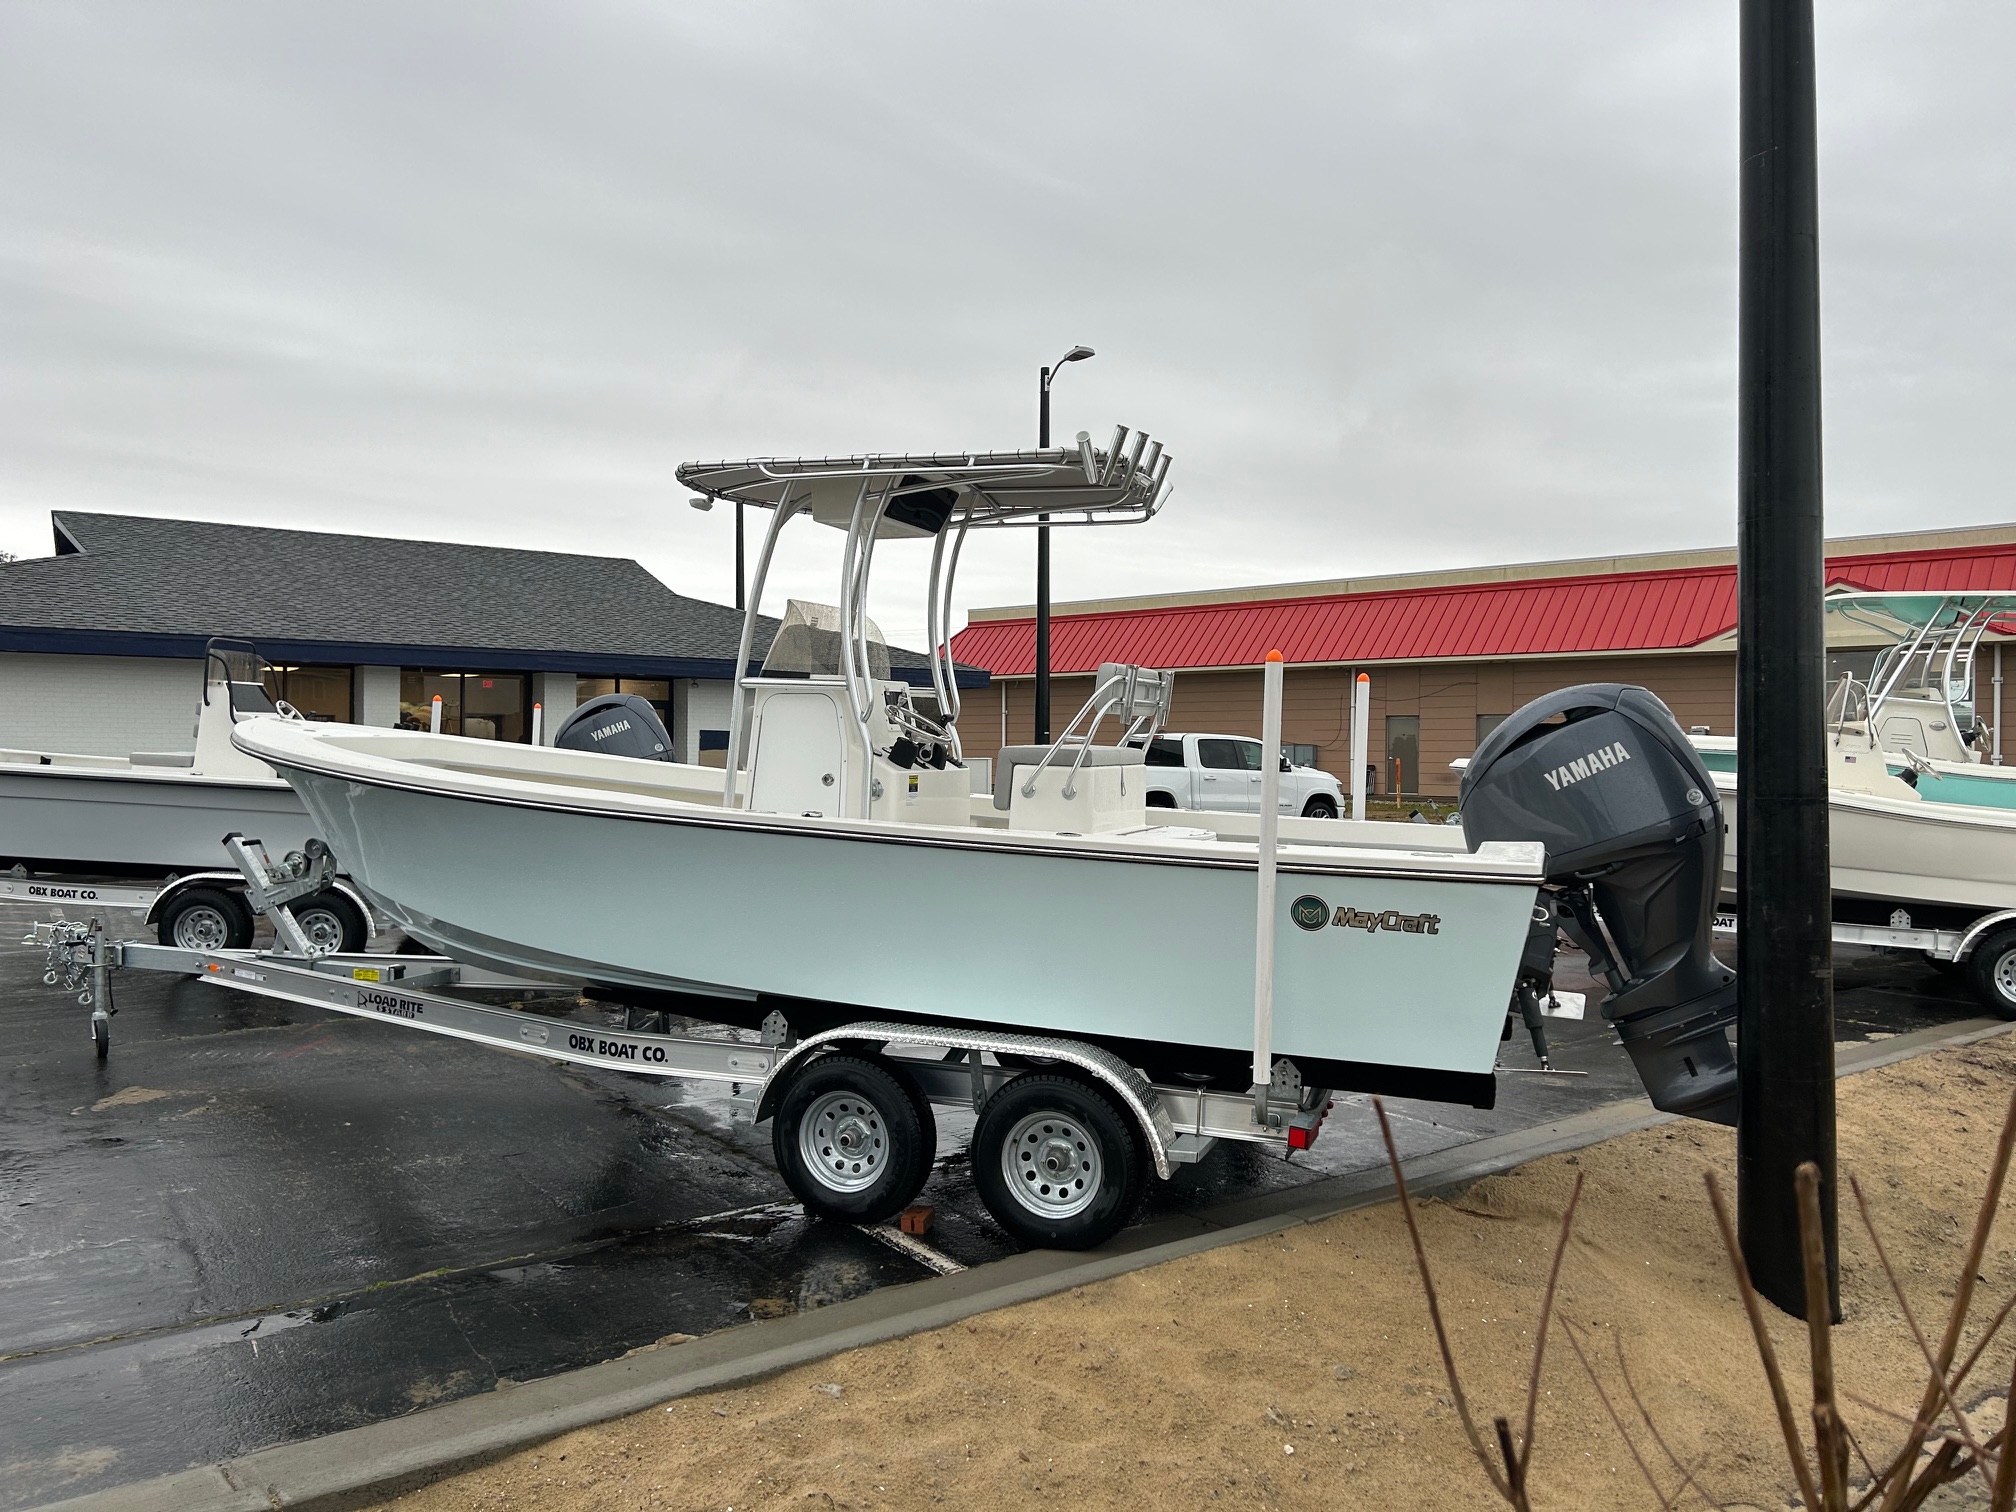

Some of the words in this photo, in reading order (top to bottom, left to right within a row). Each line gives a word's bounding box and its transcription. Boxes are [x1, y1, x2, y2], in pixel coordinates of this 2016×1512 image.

[590, 719, 631, 742] YAMAHA
[1543, 741, 1631, 791] YAMAHA
[28, 885, 48, 896] OBX
[50, 888, 78, 898] BOAT
[80, 890, 98, 900] CO.
[1331, 906, 1441, 935] MayCraft
[1712, 917, 1735, 928] OAT
[368, 993, 397, 1007] LOAD
[399, 999, 424, 1014] RITE
[568, 1033, 595, 1053] OBX
[598, 1040, 638, 1060] BOAT
[642, 1046, 669, 1063] CO.
